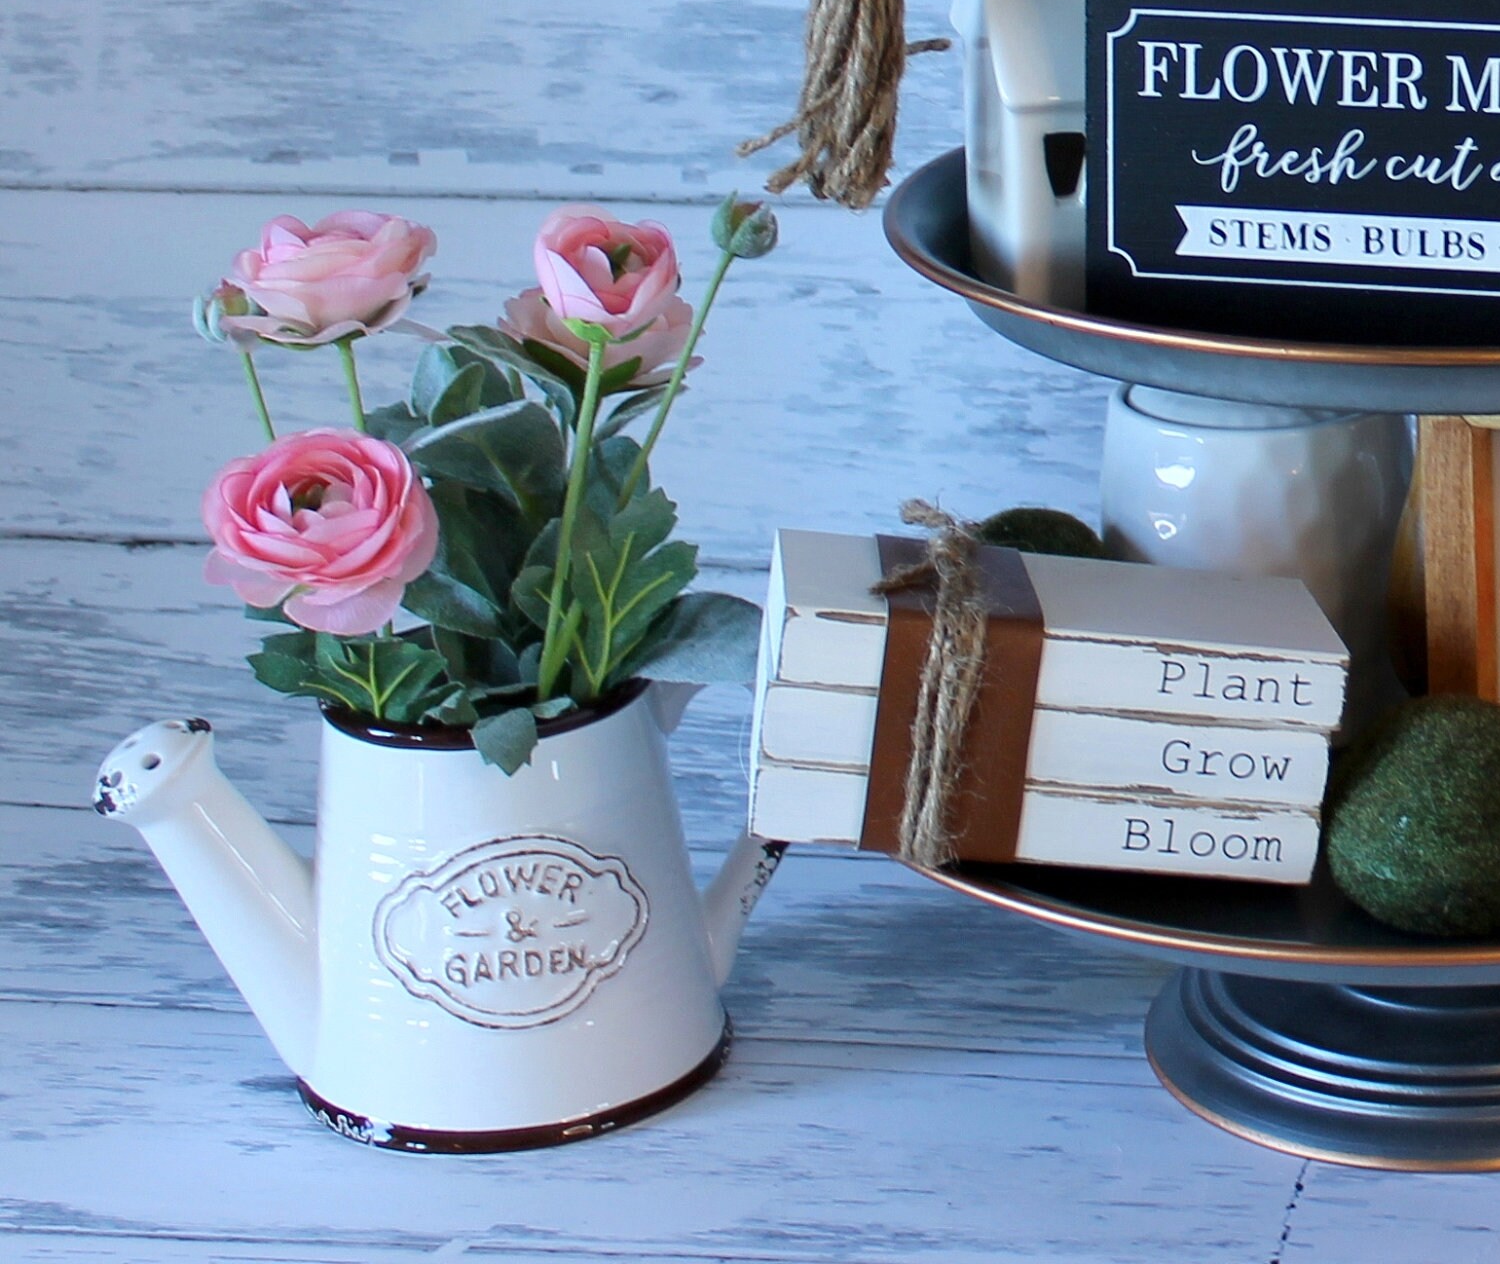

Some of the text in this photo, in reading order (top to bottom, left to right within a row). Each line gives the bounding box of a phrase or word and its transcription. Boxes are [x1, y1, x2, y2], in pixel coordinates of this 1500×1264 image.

[1137, 40, 1428, 111] FLOWER
[1191, 123, 1378, 194] fresh
[1384, 137, 1484, 192] cut
[1208, 217, 1332, 253] STEMS
[1362, 225, 1487, 261] BULBS
[1157, 659, 1315, 708] Plant
[1161, 739, 1292, 783] Grow
[1122, 818, 1284, 863] Bloom
[440, 863, 584, 918] FLOWER
[504, 910, 539, 943] &
[445, 944, 587, 988] GARDEN
